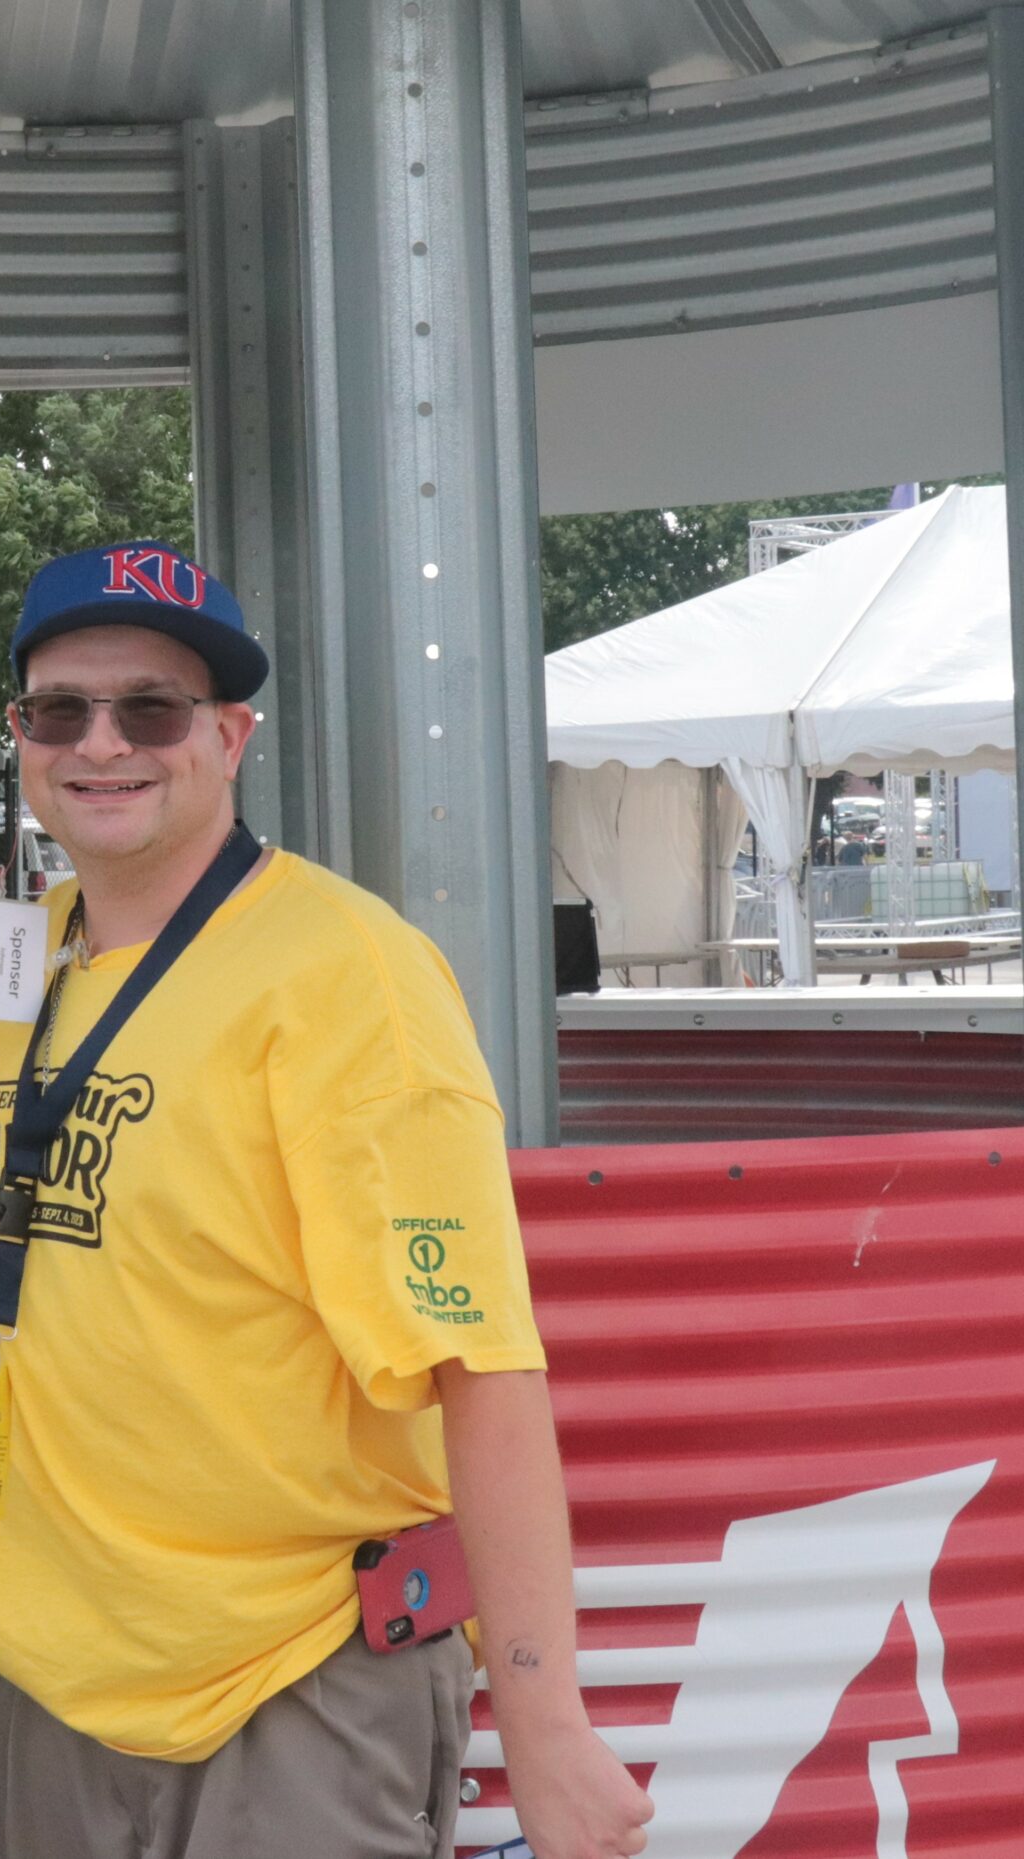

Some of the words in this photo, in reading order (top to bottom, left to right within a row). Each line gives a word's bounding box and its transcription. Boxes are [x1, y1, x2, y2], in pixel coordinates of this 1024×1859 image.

[103, 548, 207, 609] KU
[9, 927, 26, 998] Spenser
[392, 1218, 465, 1231] OFFICIAL
